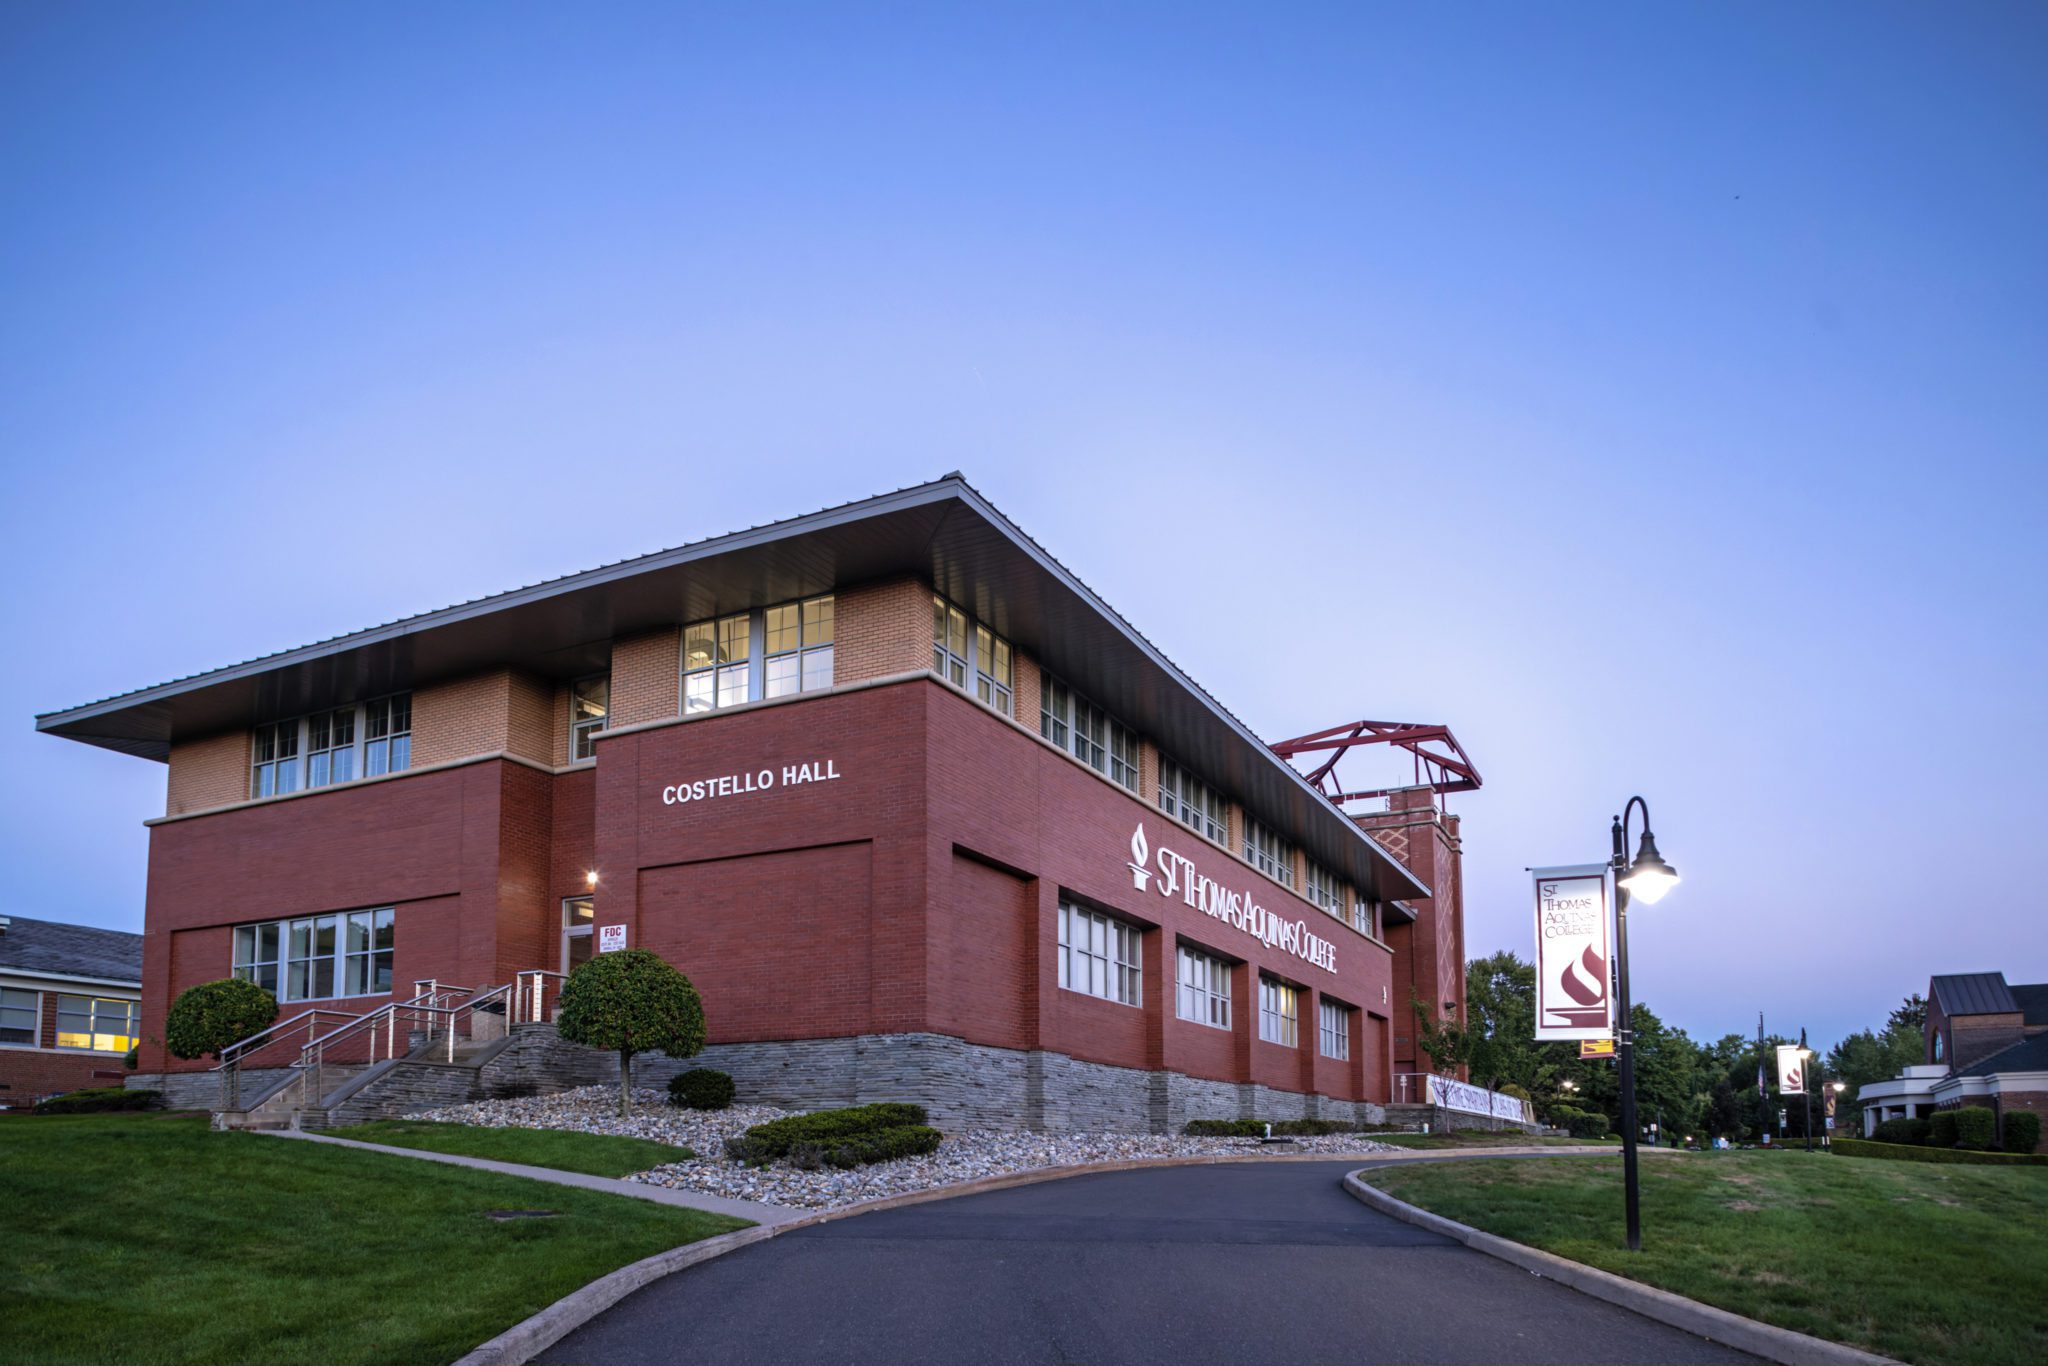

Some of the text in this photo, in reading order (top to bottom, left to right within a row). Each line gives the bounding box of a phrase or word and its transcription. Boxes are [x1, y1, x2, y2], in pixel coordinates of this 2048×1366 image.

[662, 759, 841, 805] COSTELLO HALL
[1179, 856, 1242, 930] THOMAS
[1241, 890, 1297, 955] AQUINAS
[1295, 920, 1337, 974] COLLEGE
[1543, 898, 1592, 911] THOMAS
[604, 927, 621, 937] FDC
